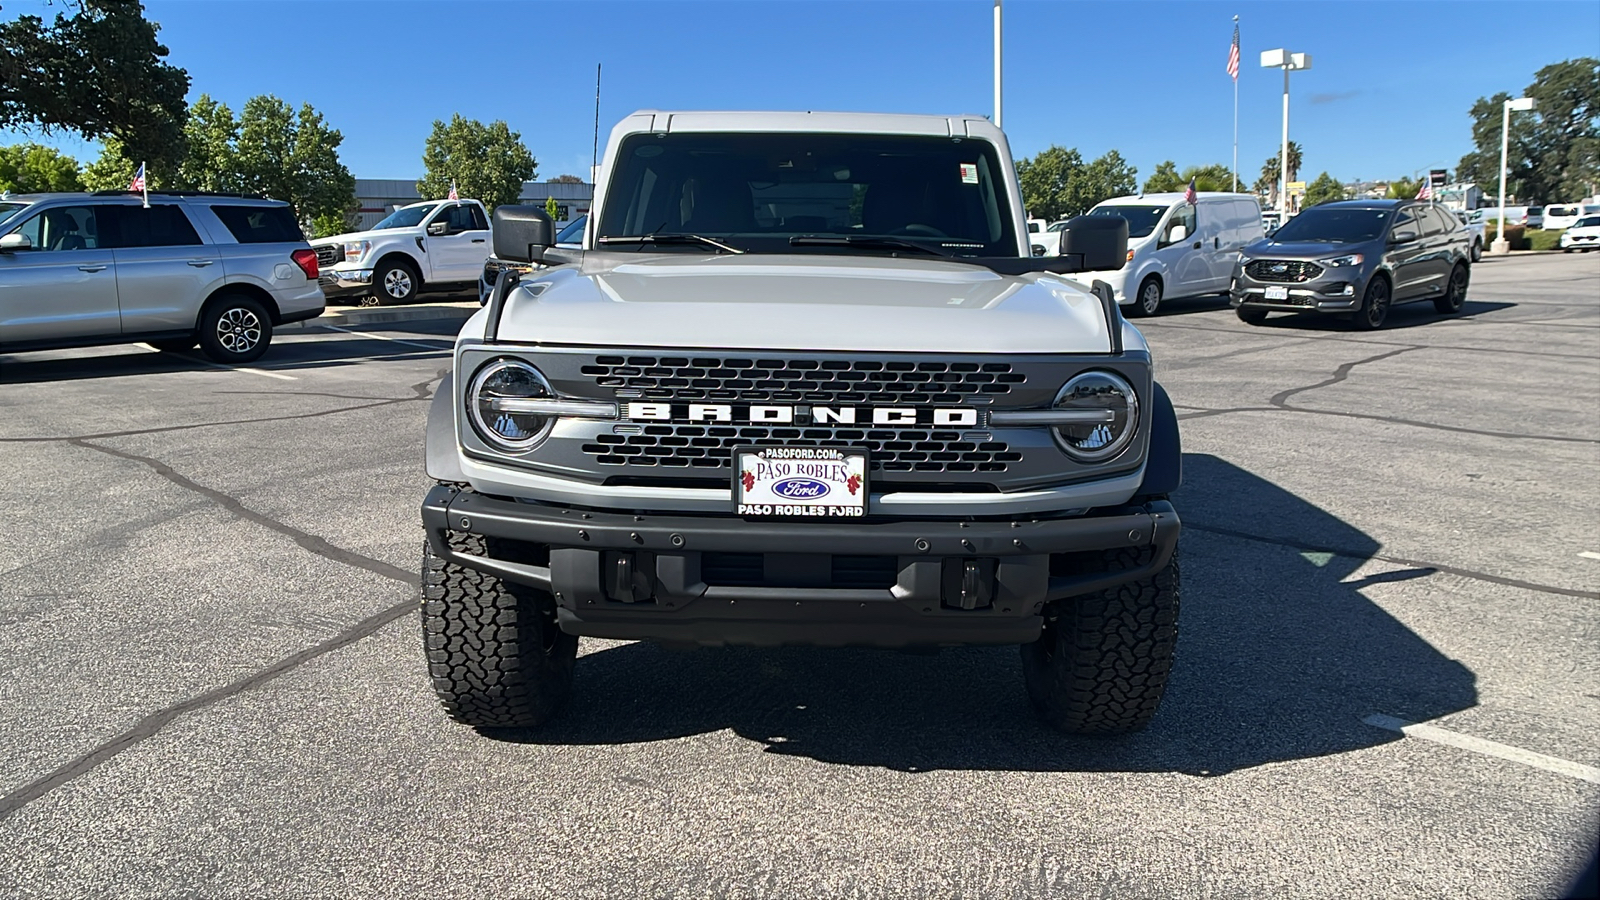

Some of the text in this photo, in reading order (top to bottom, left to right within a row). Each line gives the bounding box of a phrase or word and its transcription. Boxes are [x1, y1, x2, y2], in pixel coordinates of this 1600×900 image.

[628, 402, 978, 426] BRONCO
[766, 448, 837, 460] PASOFORD.COM
[757, 462, 848, 484] PASO ROBLES
[783, 480, 820, 497] Ford
[738, 504, 863, 517] PASO ROBLES FORD
